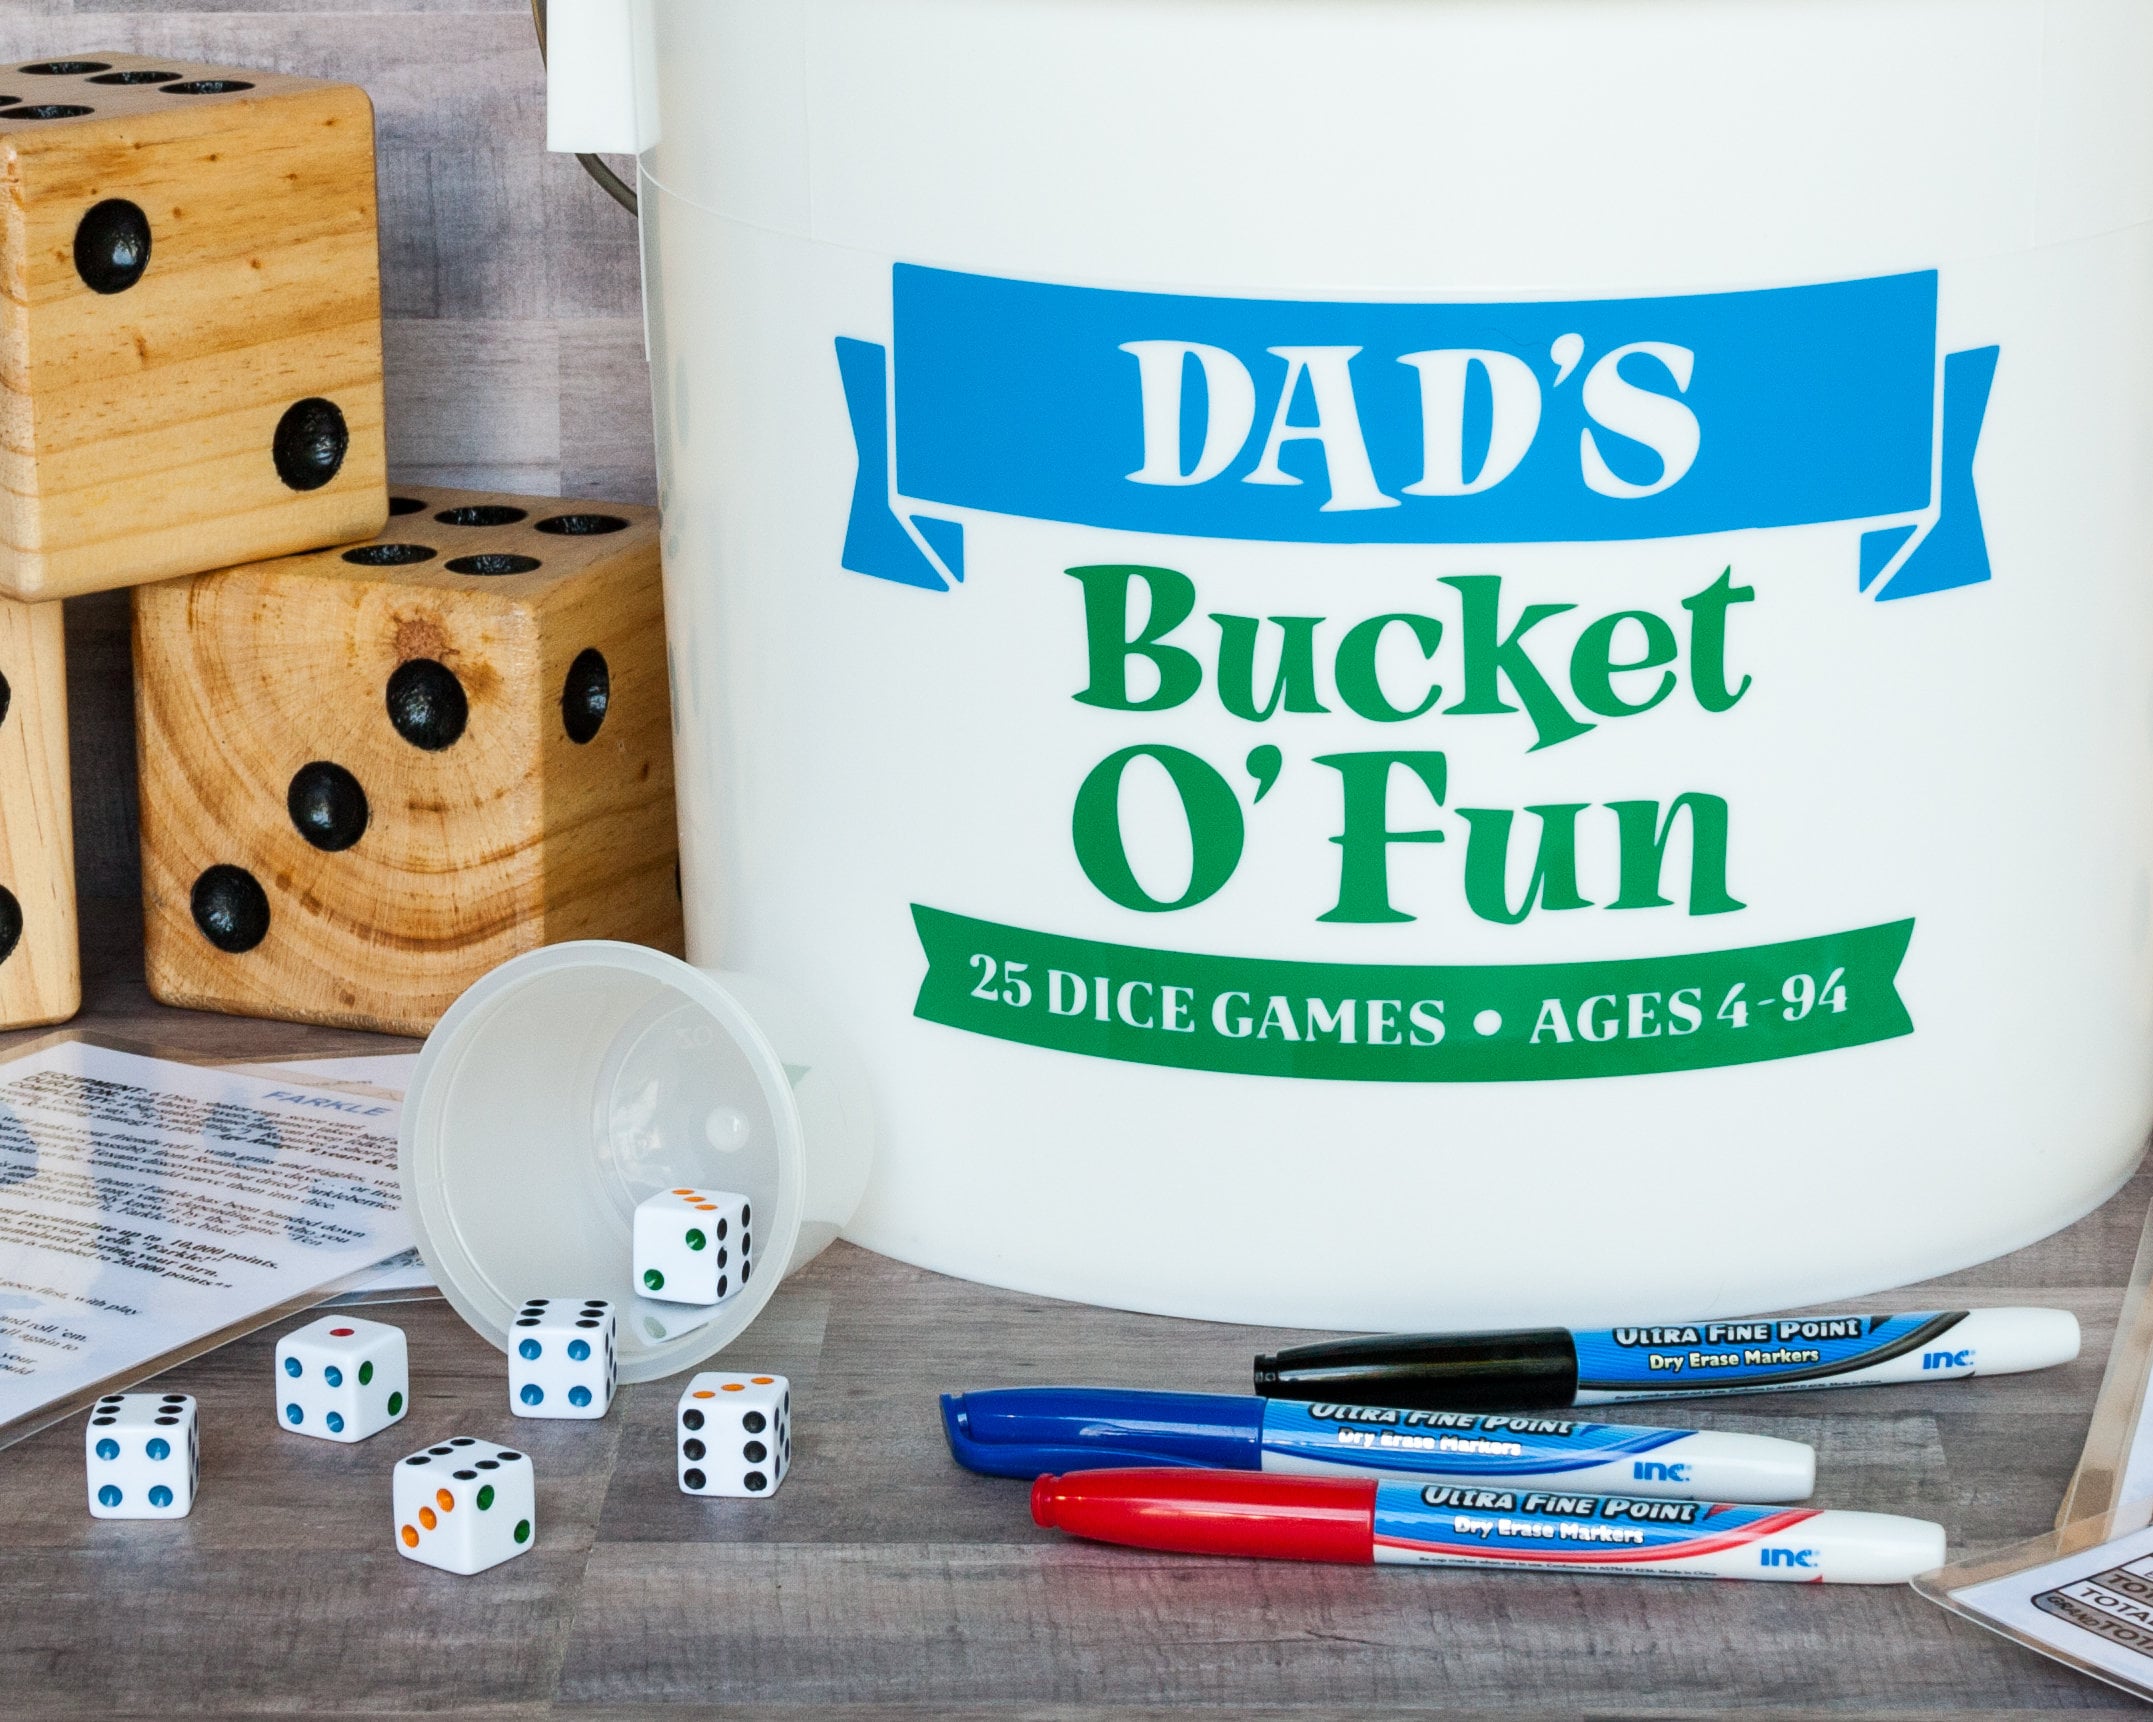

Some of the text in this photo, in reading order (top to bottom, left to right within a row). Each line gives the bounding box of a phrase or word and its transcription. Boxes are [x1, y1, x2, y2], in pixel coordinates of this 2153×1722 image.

[1118, 332, 1701, 513] DAD'S
[1064, 563, 1756, 754] Bucket
[968, 952, 1034, 1011] 25
[1047, 966, 1196, 1034] DICE
[1210, 990, 1446, 1048] GAMES
[1528, 988, 1704, 1046] AGES
[1649, 1348, 1819, 1372] Dry Erase Markers
[1338, 1429, 1522, 1456] Dry Erase Markers
[1453, 1516, 1645, 1544] Dry Erase Markers
